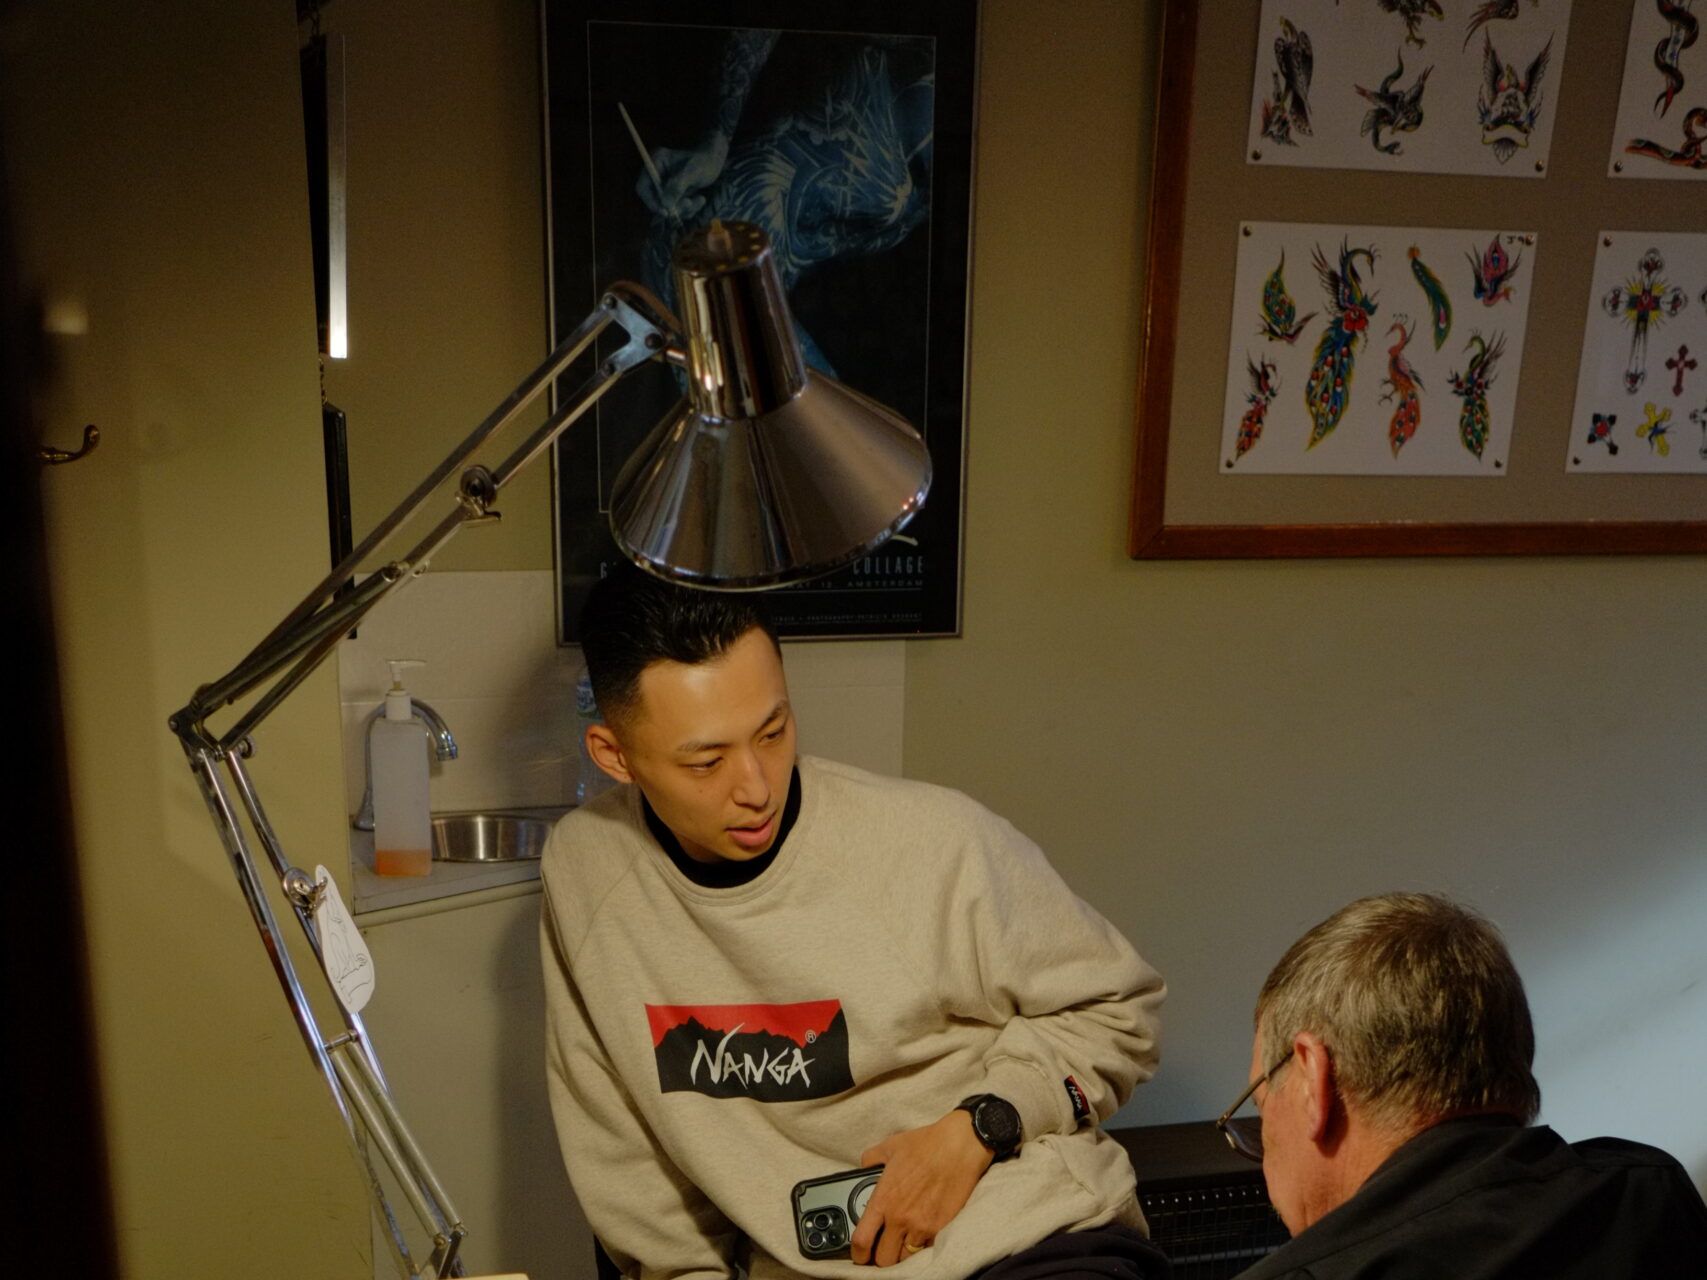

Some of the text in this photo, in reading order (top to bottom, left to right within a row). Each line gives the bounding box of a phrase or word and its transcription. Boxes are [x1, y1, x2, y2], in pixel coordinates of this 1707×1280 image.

[852, 555, 924, 576] COLLAGE
[847, 579, 924, 589] AMSTERDAM
[690, 1022, 816, 1090] NANGA
